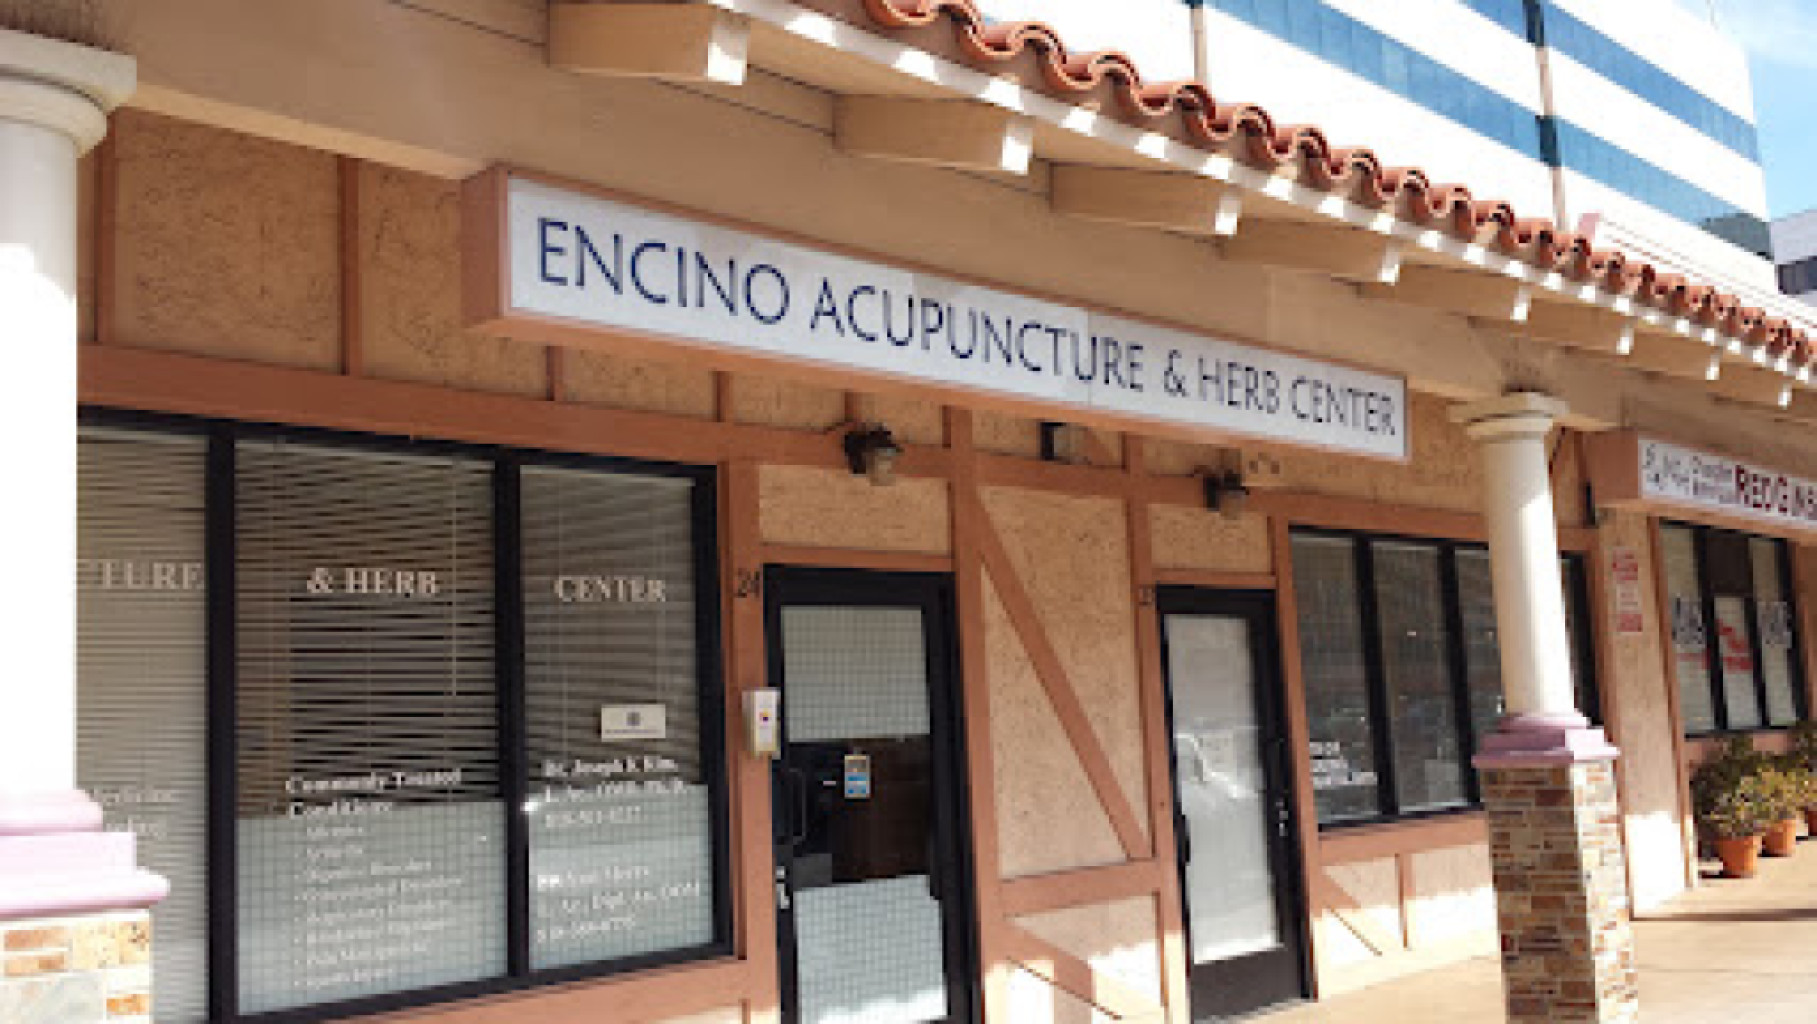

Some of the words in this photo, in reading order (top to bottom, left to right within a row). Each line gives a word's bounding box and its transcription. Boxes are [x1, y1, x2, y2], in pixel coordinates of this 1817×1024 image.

[537, 217, 790, 325] ENCINO
[810, 277, 1144, 392] ACUPUNCTURE
[1163, 349, 1188, 398] &
[1199, 357, 1281, 414] HERB
[1291, 375, 1397, 436] CENTER
[306, 567, 334, 594] &
[345, 568, 440, 595] HERB
[554, 574, 667, 603] CENTER
